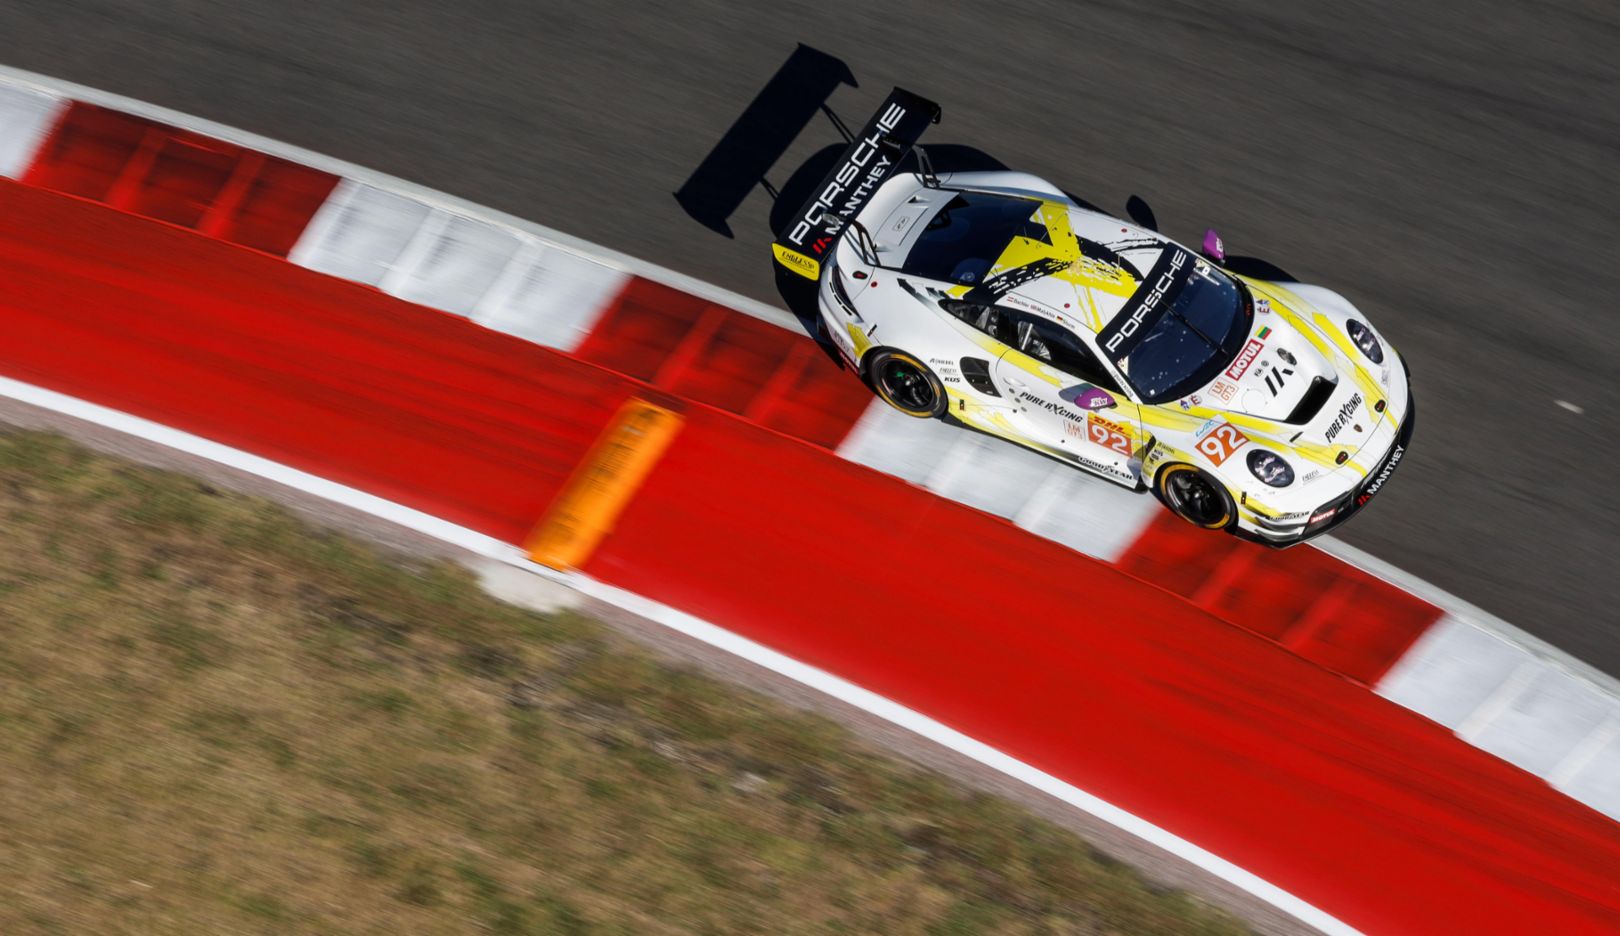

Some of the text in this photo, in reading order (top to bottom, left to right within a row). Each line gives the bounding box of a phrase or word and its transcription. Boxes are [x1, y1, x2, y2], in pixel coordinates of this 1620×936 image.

[789, 103, 906, 245] PORSCHE
[825, 155, 891, 235] MANTHEY
[1105, 249, 1187, 353] PORSCHE
[1231, 341, 1261, 380] MOTUL
[1019, 391, 1044, 406] PURE
[1211, 381, 1225, 394] LM
[1220, 385, 1237, 401] GT3
[1094, 416, 1128, 433] DHL
[1325, 418, 1343, 444] PURE
[1091, 425, 1129, 455] 92
[1200, 426, 1246, 461] 92
[1078, 456, 1133, 480] GOODYEAR
[1367, 445, 1404, 496] MANTHEY
